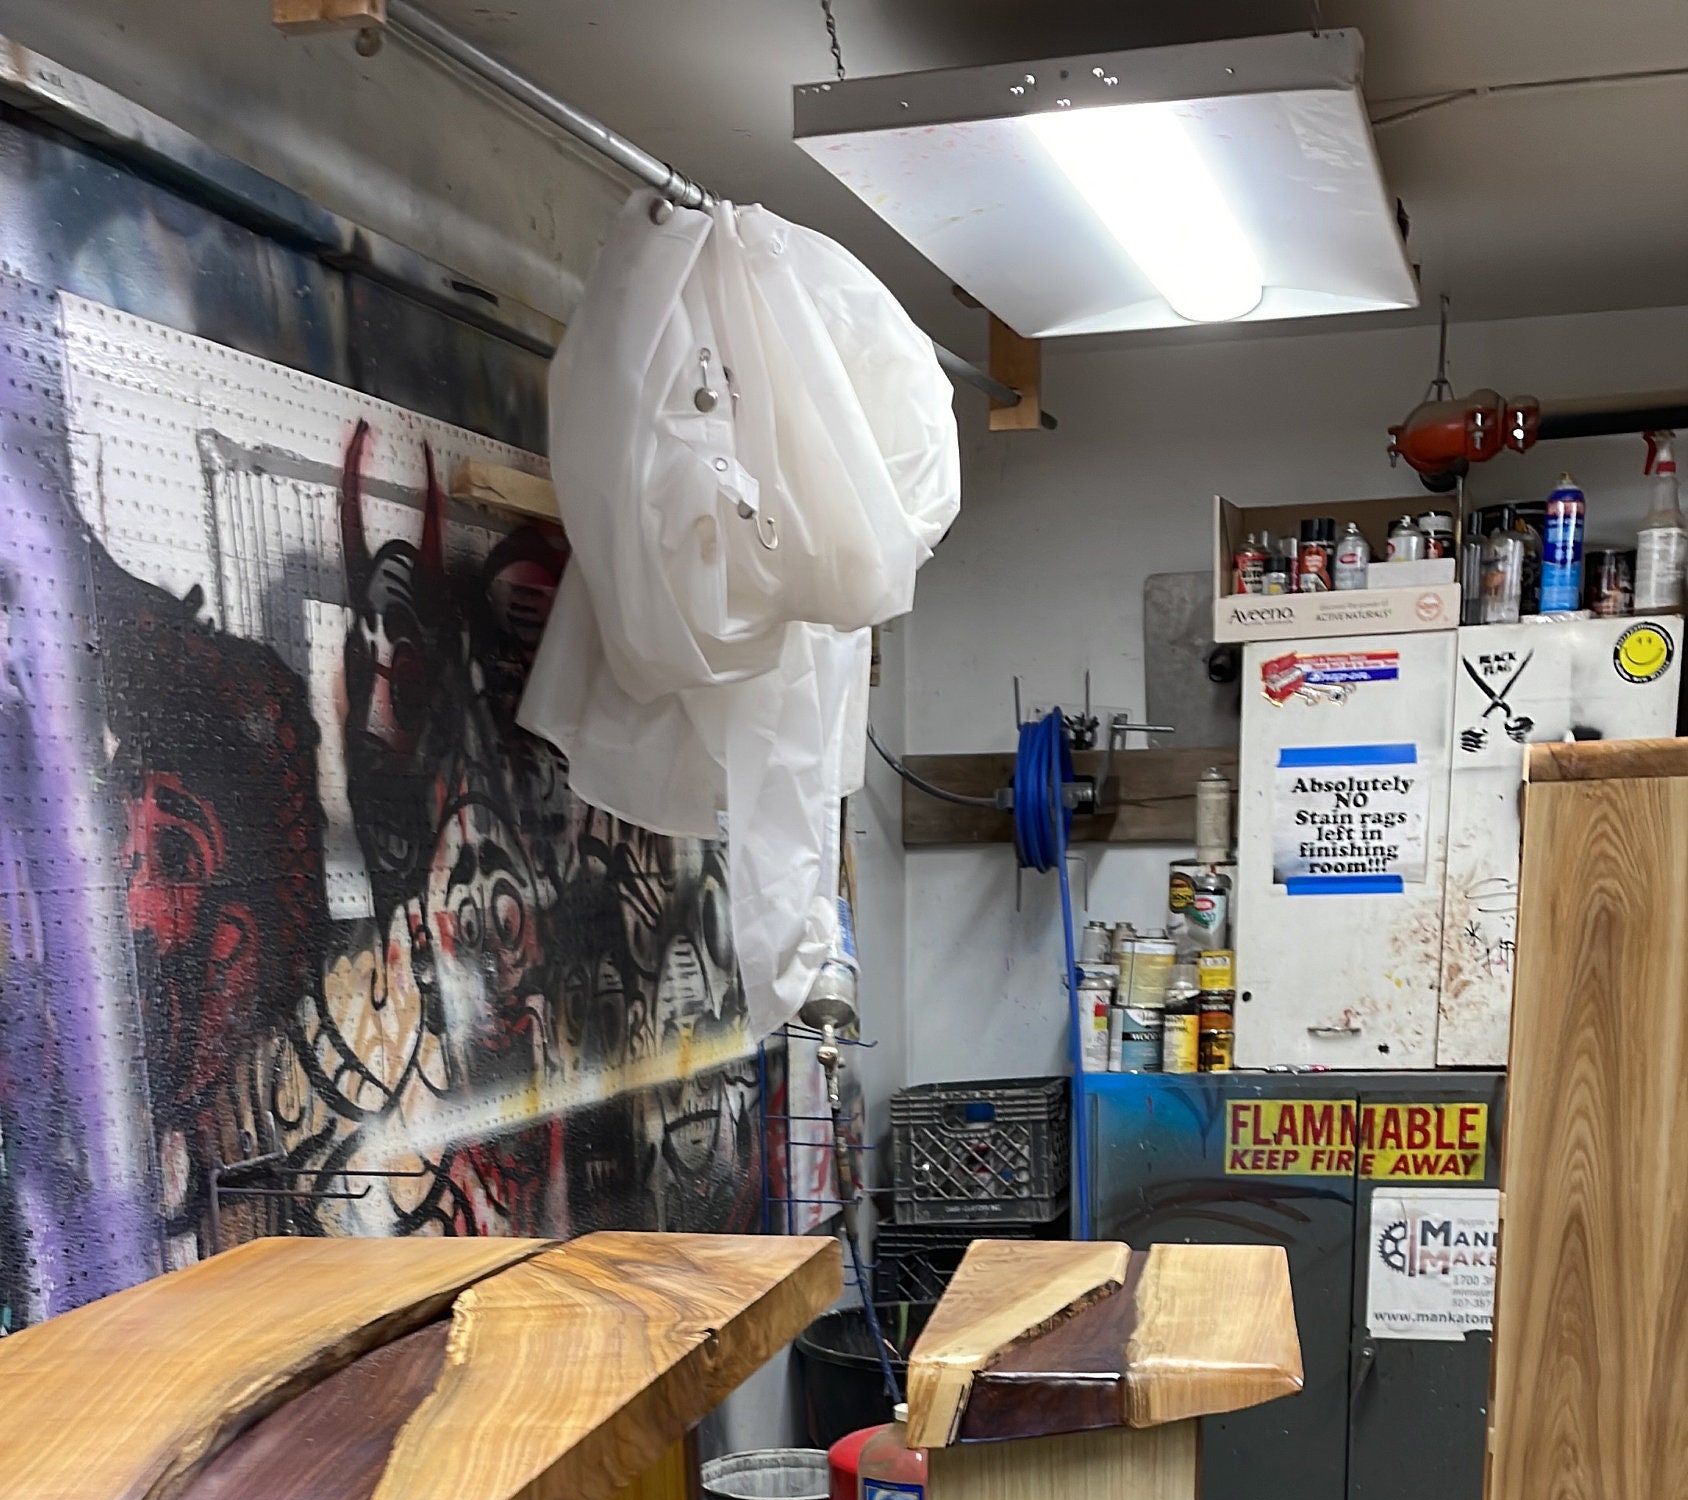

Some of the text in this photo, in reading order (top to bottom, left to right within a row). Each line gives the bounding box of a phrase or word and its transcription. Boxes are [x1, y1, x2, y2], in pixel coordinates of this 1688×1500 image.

[1229, 607, 1294, 625] Aveeno
[1291, 776, 1414, 794] Absolutely
[1335, 792, 1369, 808] NO
[1295, 808, 1407, 828] Stain rags
[1316, 824, 1382, 841] left in
[1299, 841, 1399, 861] finishing
[1309, 858, 1388, 873] room!!!
[1229, 1103, 1480, 1150] FLAMMABLE
[1228, 1149, 1479, 1175] KEEP FIRE AWAY
